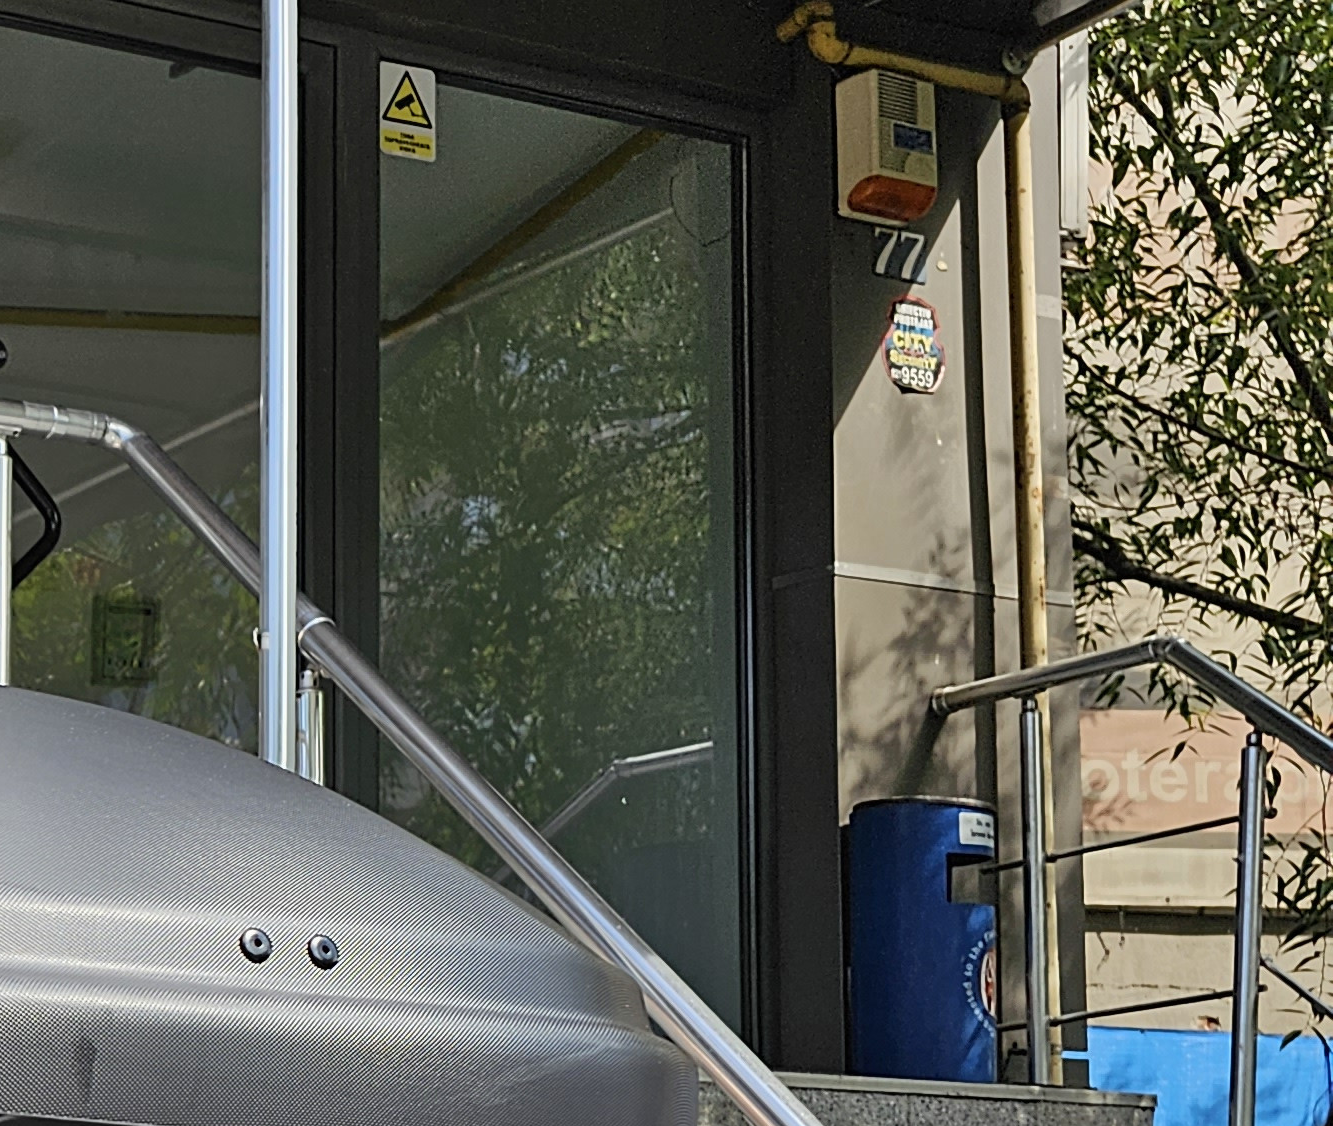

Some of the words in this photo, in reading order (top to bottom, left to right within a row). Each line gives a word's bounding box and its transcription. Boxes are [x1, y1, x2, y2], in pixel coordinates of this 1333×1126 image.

[874, 227, 925, 282] 77
[892, 329, 934, 353] CITY
[901, 366, 934, 388] 9559
